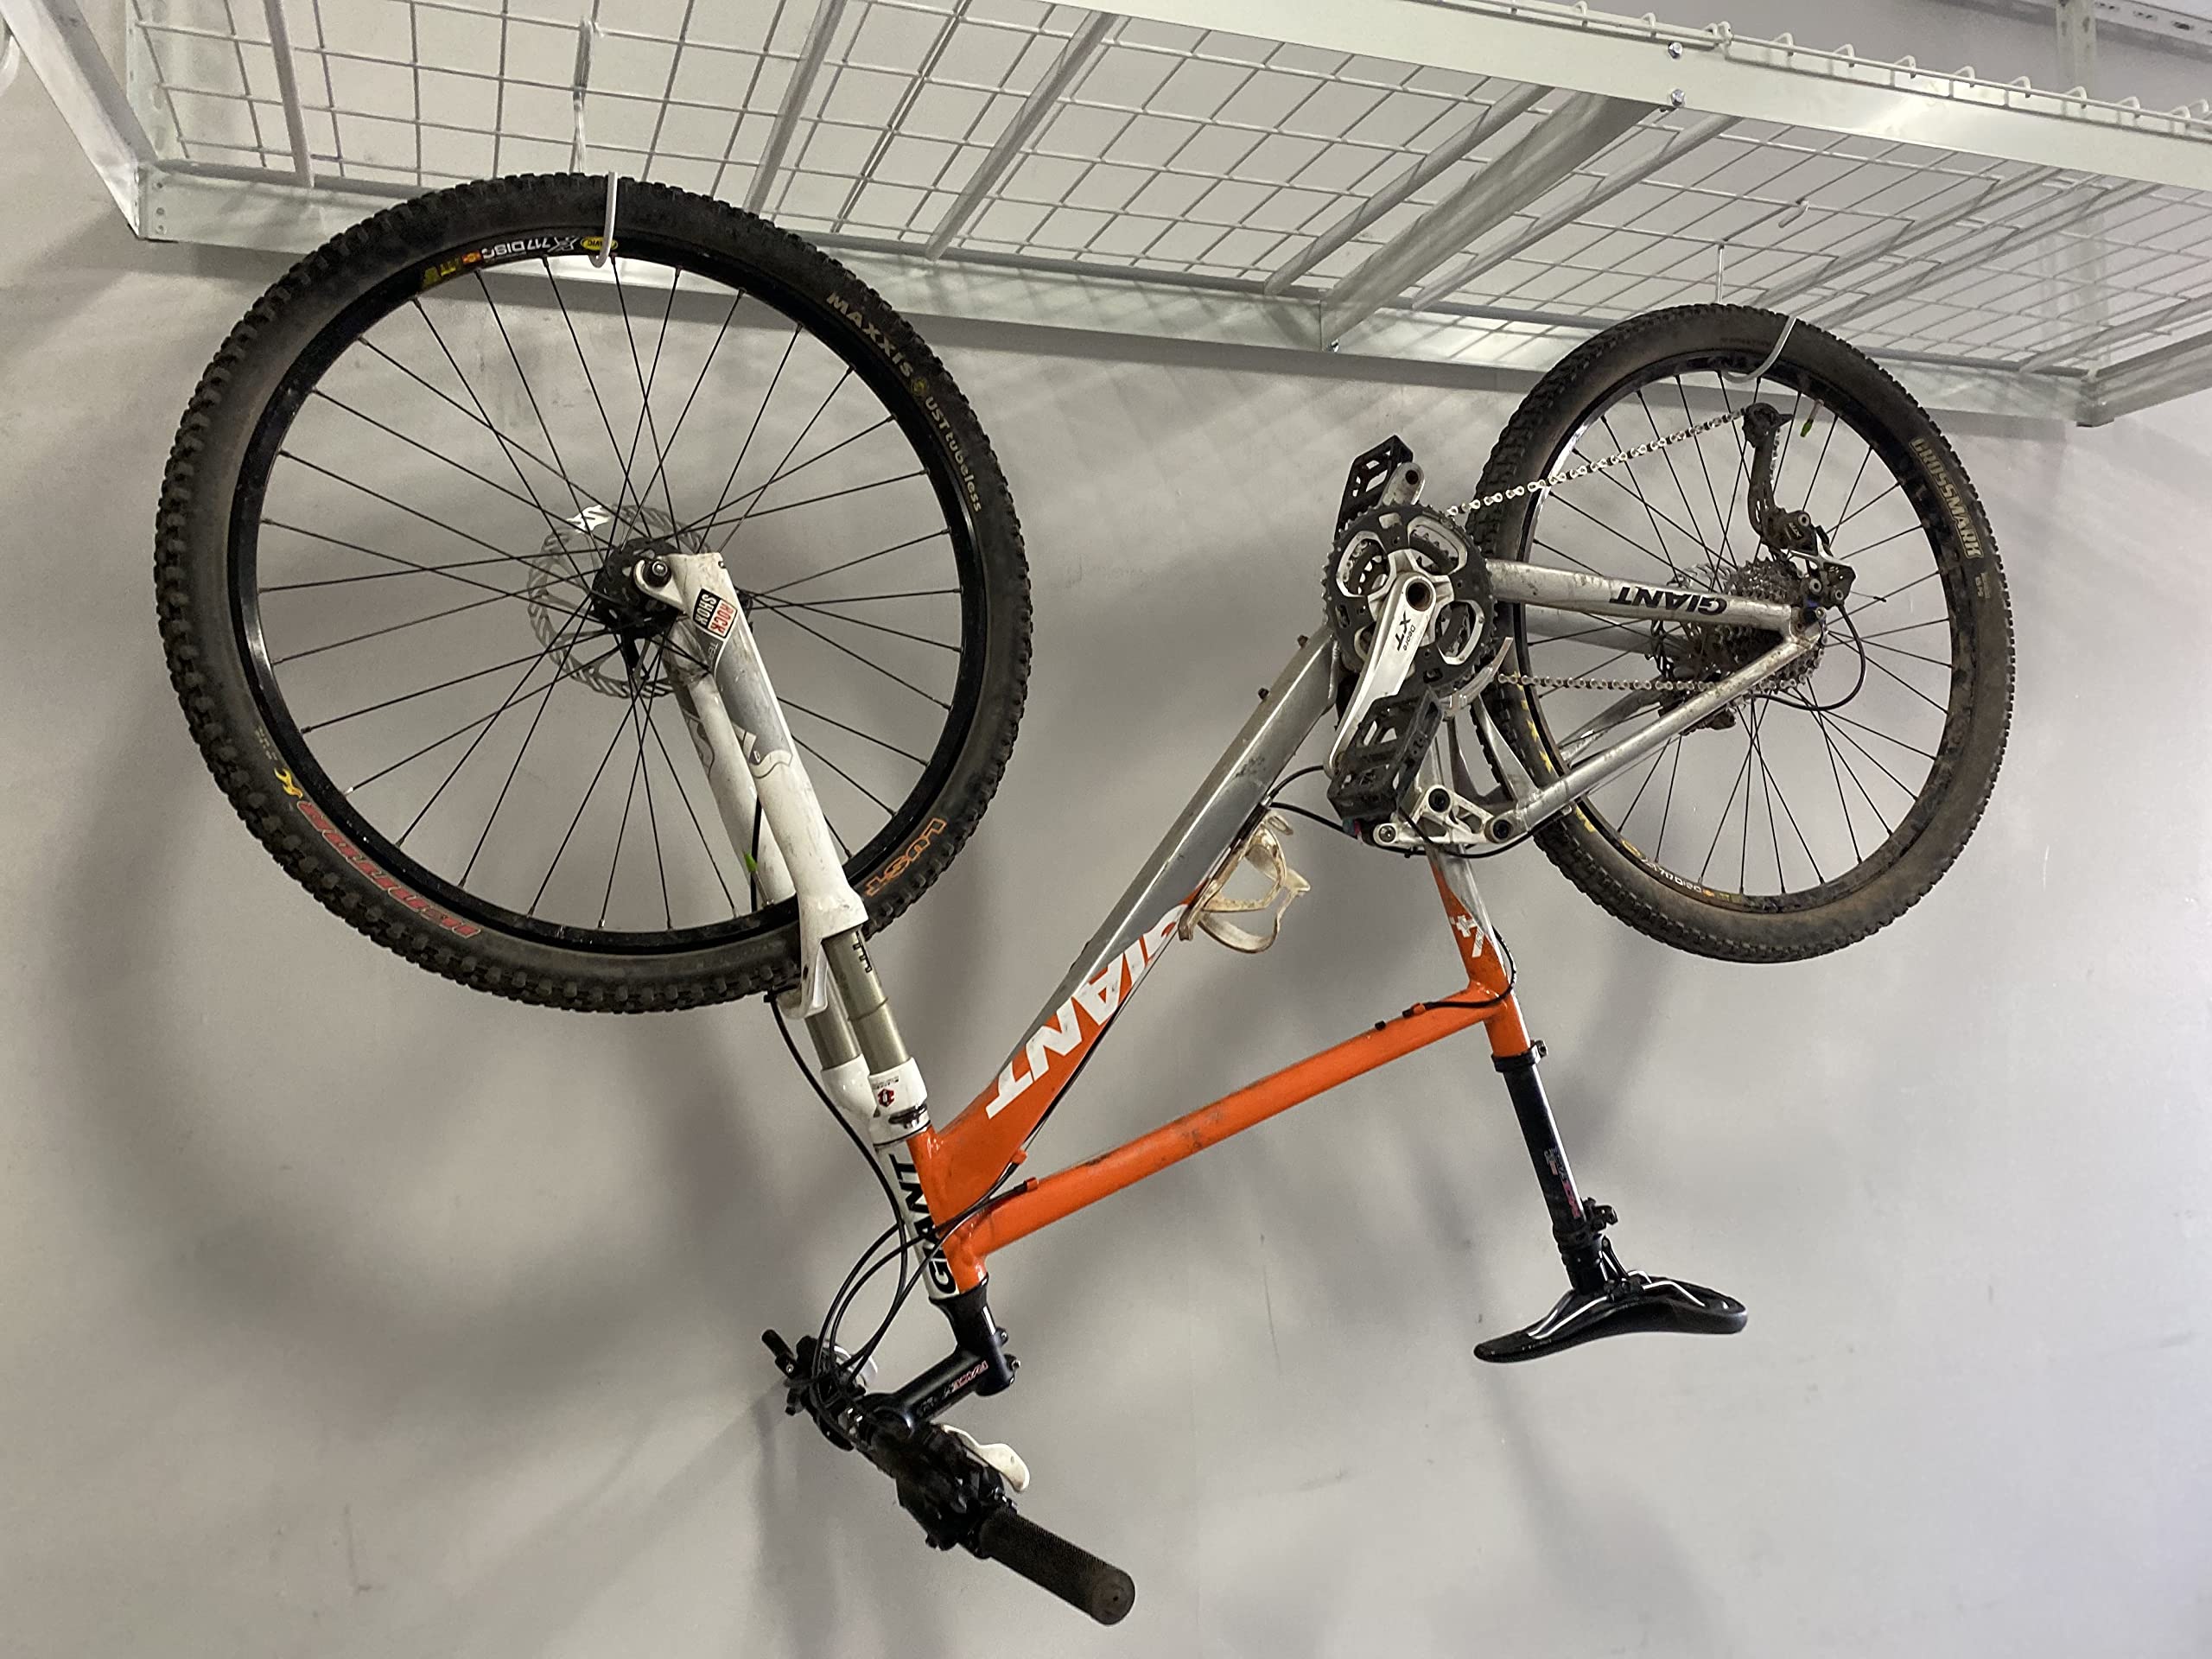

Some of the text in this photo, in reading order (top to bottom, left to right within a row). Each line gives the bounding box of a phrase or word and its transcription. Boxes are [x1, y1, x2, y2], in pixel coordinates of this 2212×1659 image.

[826, 291, 914, 378] MAXXIS
[925, 396, 950, 429] UST
[1909, 437, 1984, 559] CROSSMARK
[695, 594, 717, 626] SHOX
[710, 602, 734, 634] ROCK
[1395, 610, 1412, 652] XT
[1609, 586, 1728, 616] GIANT
[1402, 626, 1416, 651] Deore
[866, 817, 947, 897] LUST
[985, 904, 1189, 1119] GIANT
[888, 1153, 957, 1294] GIANT
